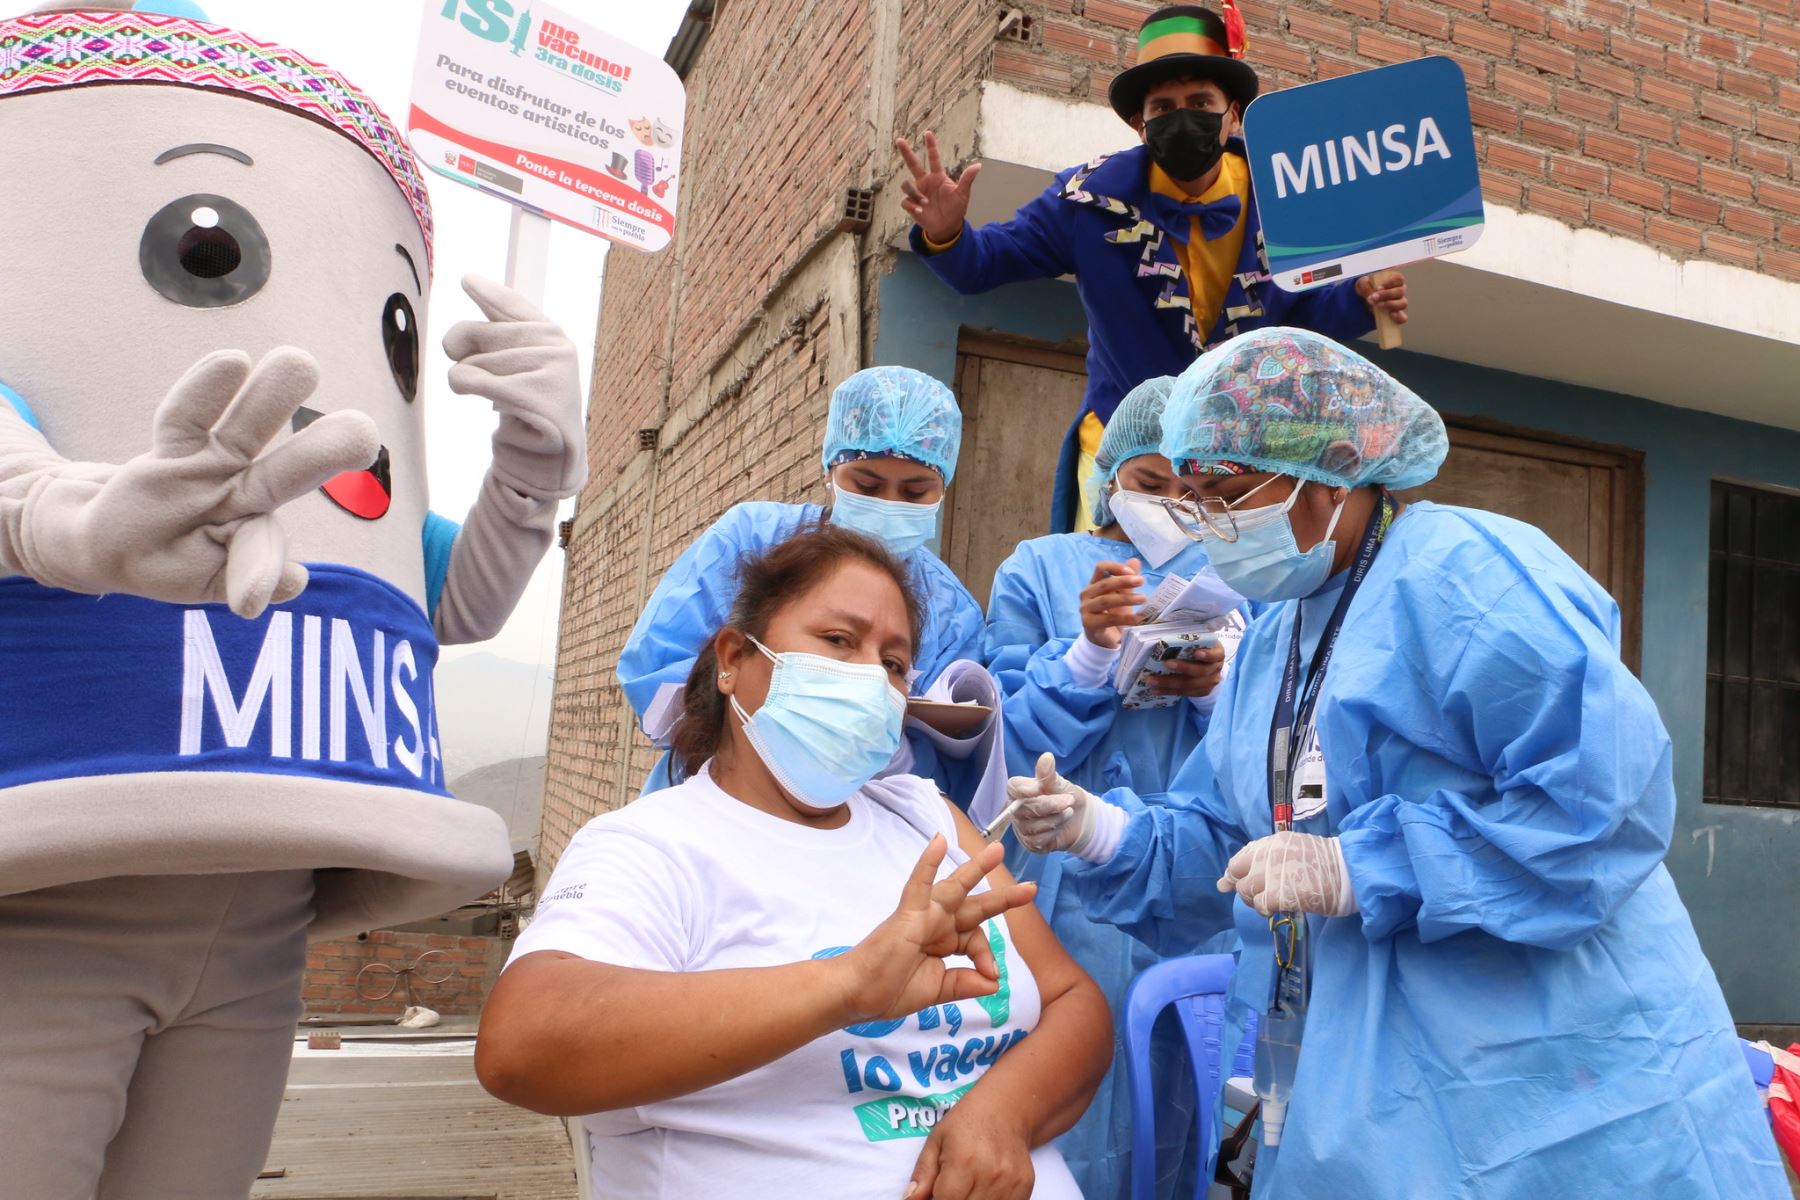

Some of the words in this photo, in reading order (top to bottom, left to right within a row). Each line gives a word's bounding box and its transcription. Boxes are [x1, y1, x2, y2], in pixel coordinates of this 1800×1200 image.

[541, 20, 579, 45] me
[535, 46, 568, 70] 3ra
[571, 63, 623, 93] dosis
[539, 31, 631, 81] vacuno!
[436, 54, 483, 84] Para
[487, 76, 571, 117] disfrutar
[575, 110, 596, 127] de
[600, 118, 625, 139] los
[445, 79, 519, 115] eventos
[1271, 117, 1452, 198] MINSA
[516, 154, 557, 179] Ponte
[559, 171, 573, 186] la
[575, 178, 625, 207] tercera
[628, 198, 663, 222] dosis
[611, 215, 646, 234] Siempre
[1354, 559, 1368, 582] DIRIS
[1364, 537, 1377, 558] LIMA
[840, 1048, 902, 1094] lo
